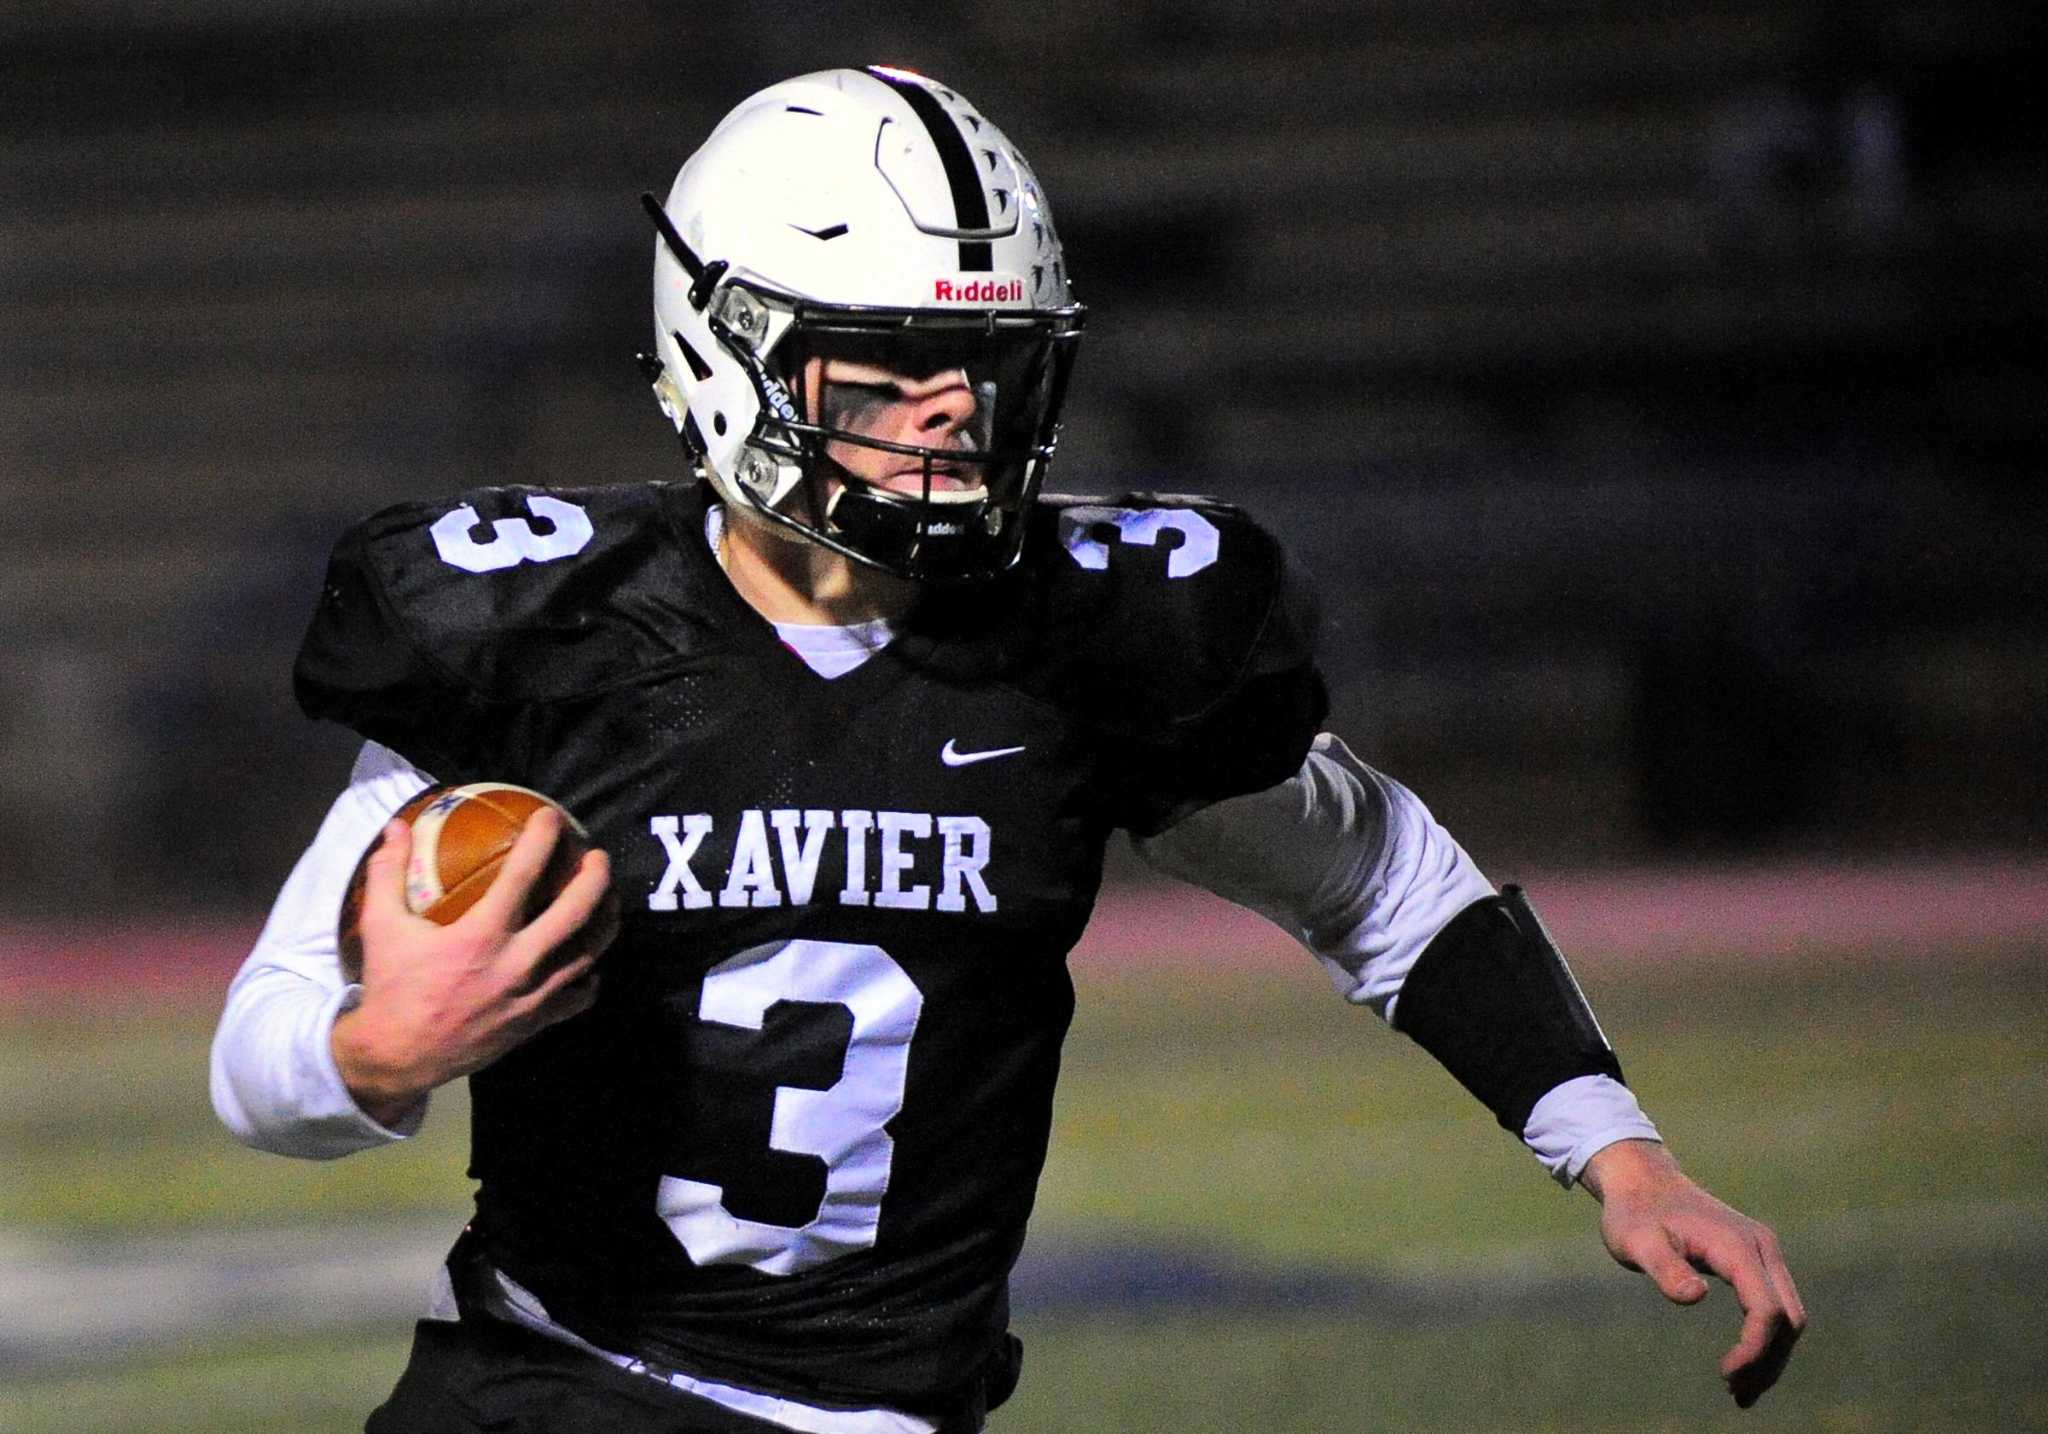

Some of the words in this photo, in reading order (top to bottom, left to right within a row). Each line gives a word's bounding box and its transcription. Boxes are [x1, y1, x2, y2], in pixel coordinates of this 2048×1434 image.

[429, 495, 594, 573] 3
[1059, 506, 1220, 578] 3
[648, 809, 998, 913] XAVIER
[655, 939, 924, 1276] 3
